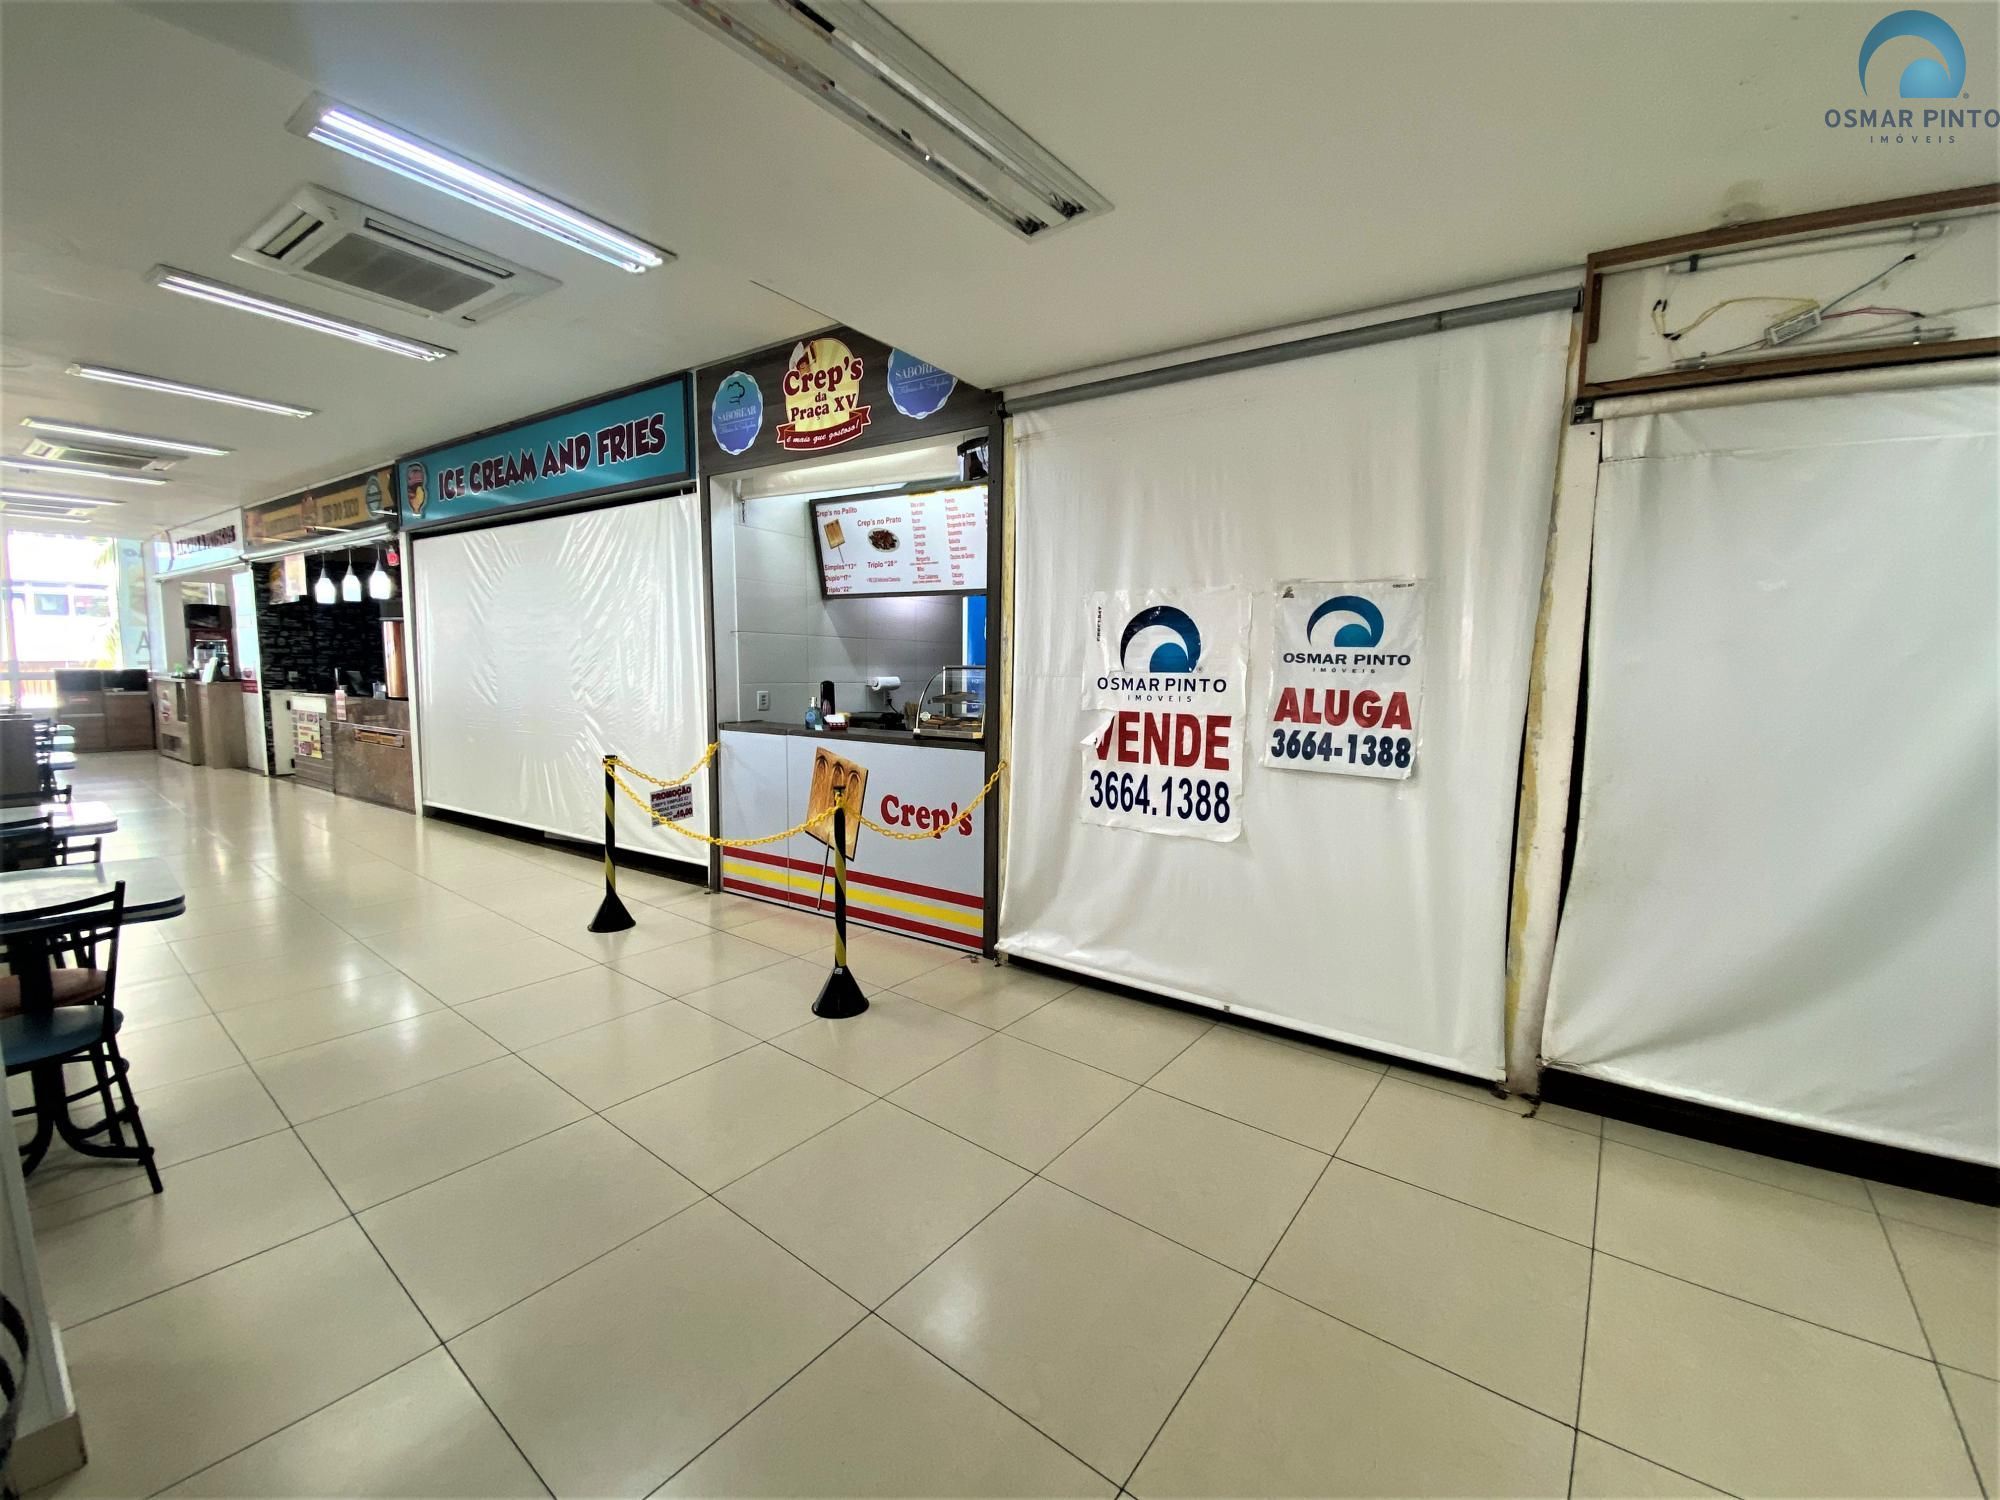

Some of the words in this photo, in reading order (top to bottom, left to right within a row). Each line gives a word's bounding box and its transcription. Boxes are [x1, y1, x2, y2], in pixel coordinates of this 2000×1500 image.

[784, 356, 864, 396] Crep's
[814, 392, 828, 404] da
[716, 405, 757, 422] SABOREAR
[790, 403, 830, 422] Praça
[833, 393, 858, 413] XV
[792, 434, 811, 444] mais
[812, 432, 828, 445] que
[437, 466, 466, 503] ICE
[468, 447, 539, 496] CREAM
[541, 432, 592, 479] AND
[596, 412, 668, 467] FRIES
[816, 509, 833, 518] Crep's
[841, 506, 858, 515] Palito
[857, 518, 877, 528] Crep's
[885, 516, 902, 525] Prato
[867, 561, 884, 569] Triplo
[1282, 652, 1348, 667] OSMAR
[1353, 653, 1412, 668] PINTO
[1097, 677, 1160, 692] OSMAR
[1165, 677, 1227, 693] PINTO
[1273, 687, 1413, 731] ALUGA
[1271, 728, 1412, 770] 3664-1388
[651, 786, 692, 802] PROMOÇÃO
[1089, 769, 1231, 824] 3664.1388
[880, 793, 974, 840] Crep's
